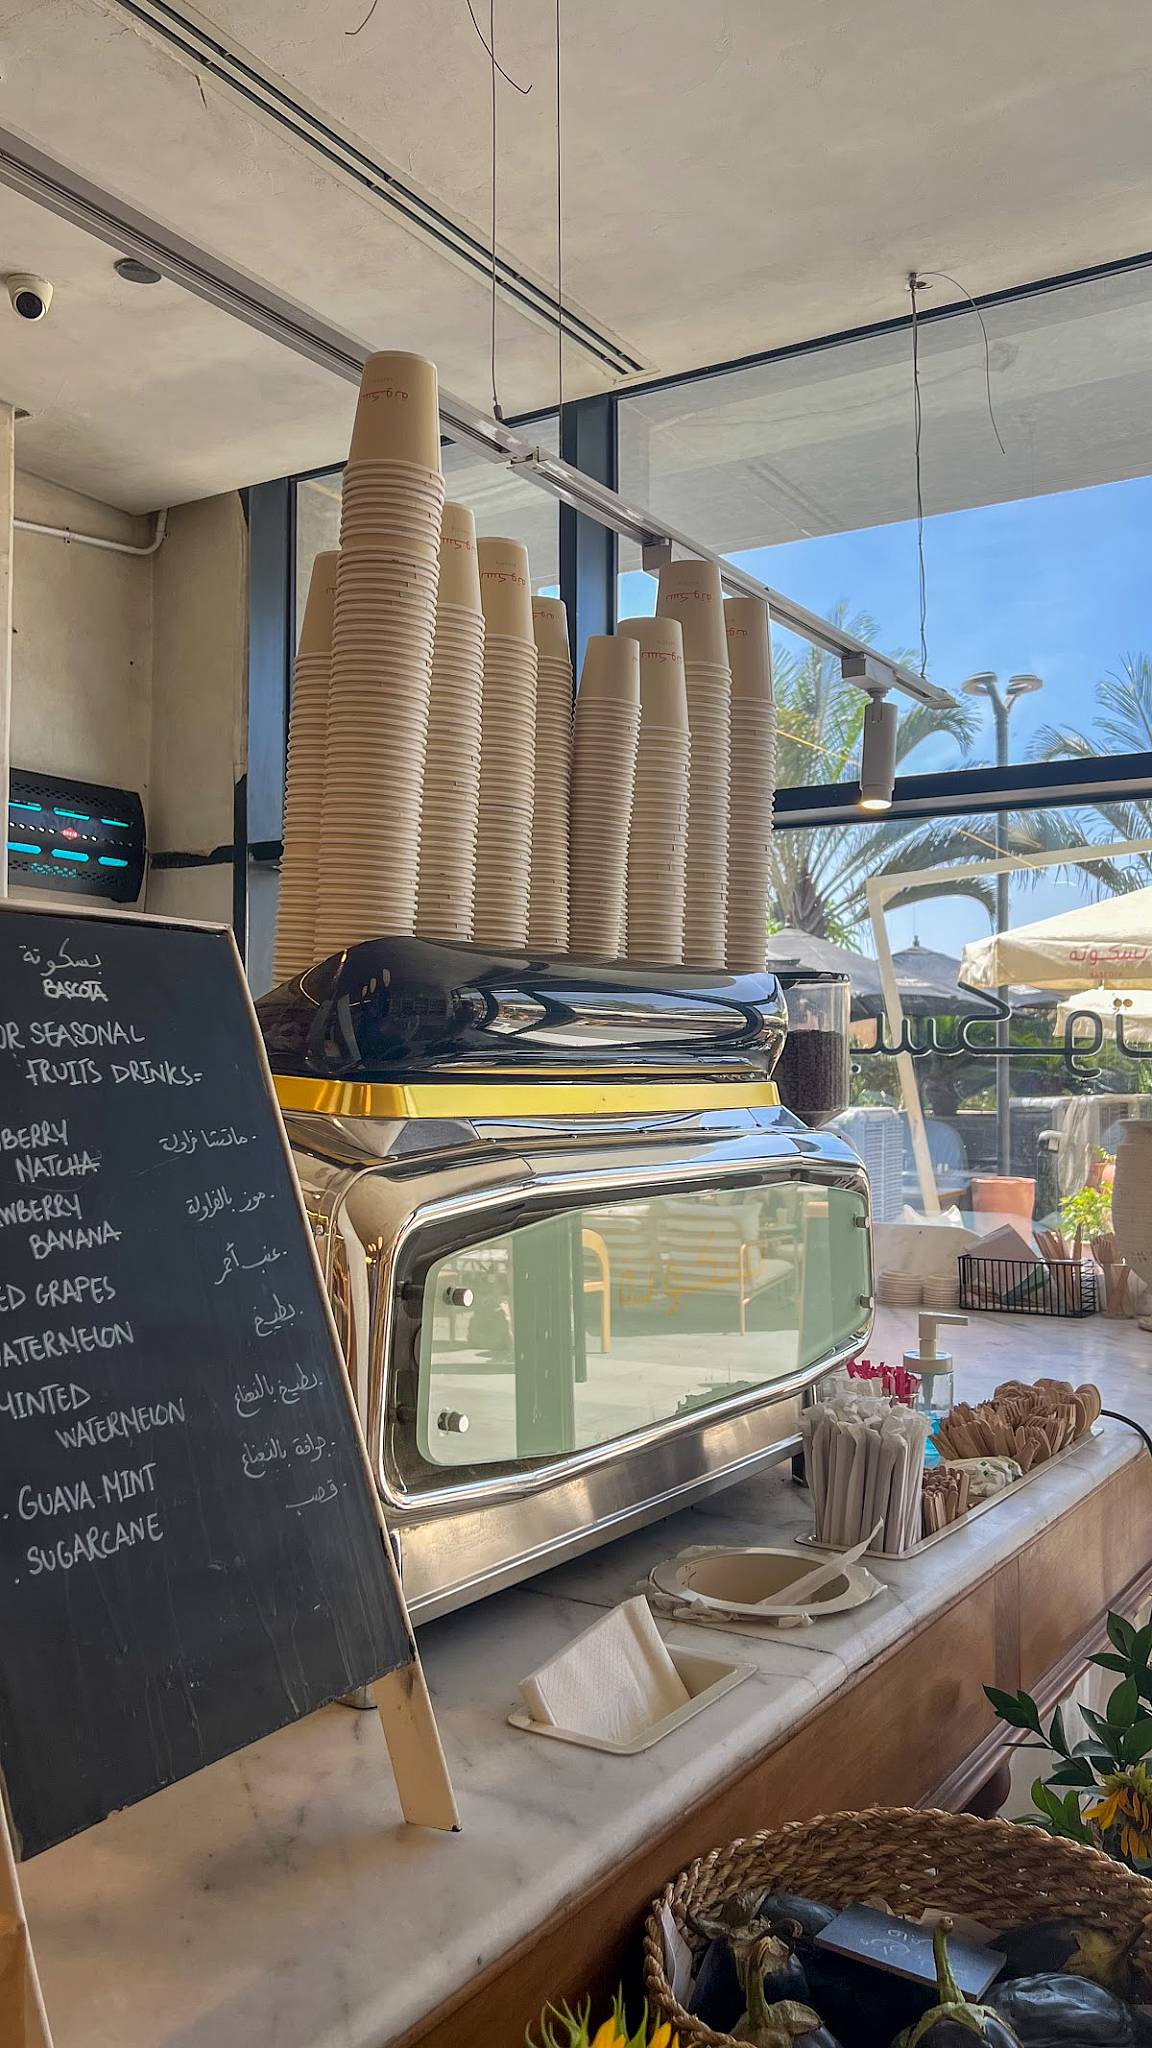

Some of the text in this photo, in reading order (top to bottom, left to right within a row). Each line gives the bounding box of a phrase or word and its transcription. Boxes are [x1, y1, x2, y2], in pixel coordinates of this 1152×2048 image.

[42, 978, 109, 1002] BASCOTA
[30, 1020, 146, 1048] SEASONAL
[26, 1057, 103, 1086] FRUITS
[0, 1119, 69, 1150] BERRY
[0, 1193, 83, 1228] WBERRY
[239, 1190, 266, 1213] موز
[29, 1220, 122, 1260] BANANA
[36, 1275, 116, 1307] GRAPES
[253, 1293, 296, 1337] بطيخ
[0, 1321, 135, 1368] ATERMELON
[55, 1397, 186, 1448] WATERMELON
[27, 1512, 164, 1575] SUGARCANE
